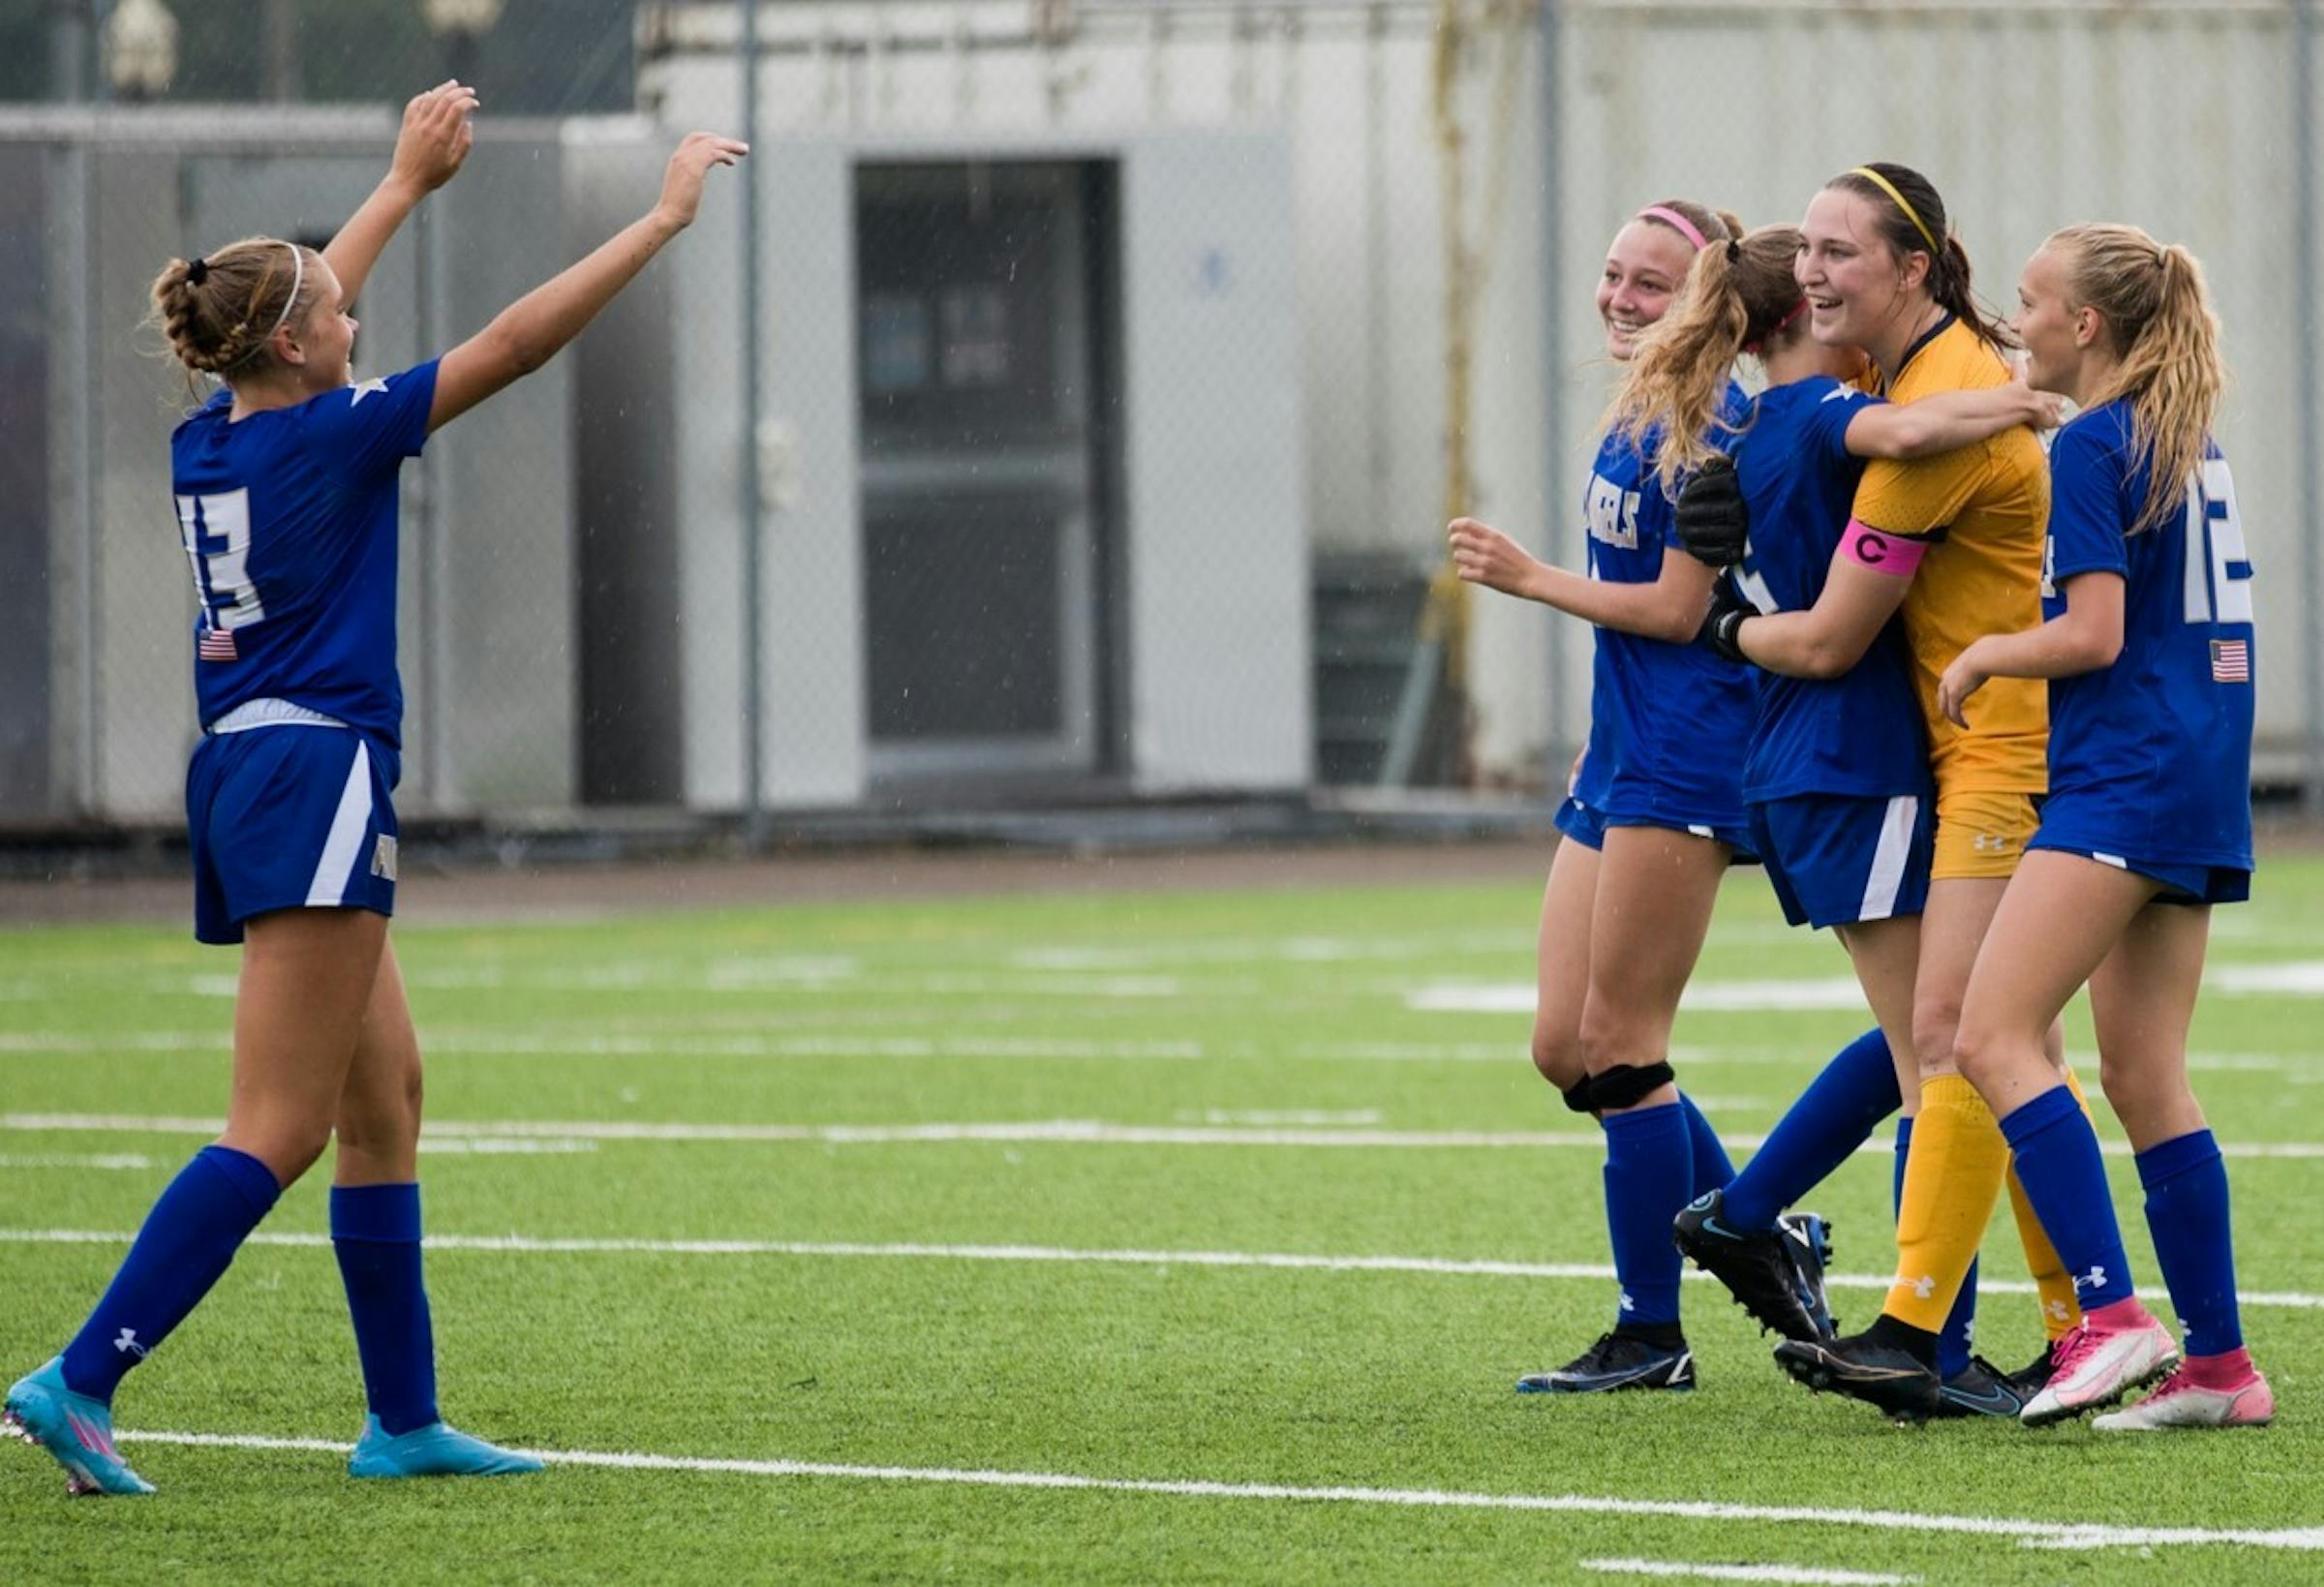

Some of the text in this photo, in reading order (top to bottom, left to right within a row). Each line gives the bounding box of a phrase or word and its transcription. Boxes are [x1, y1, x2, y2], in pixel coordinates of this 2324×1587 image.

[175, 487, 266, 630] 13
[1856, 534, 1887, 564] C
[2185, 458, 2253, 624] 12
